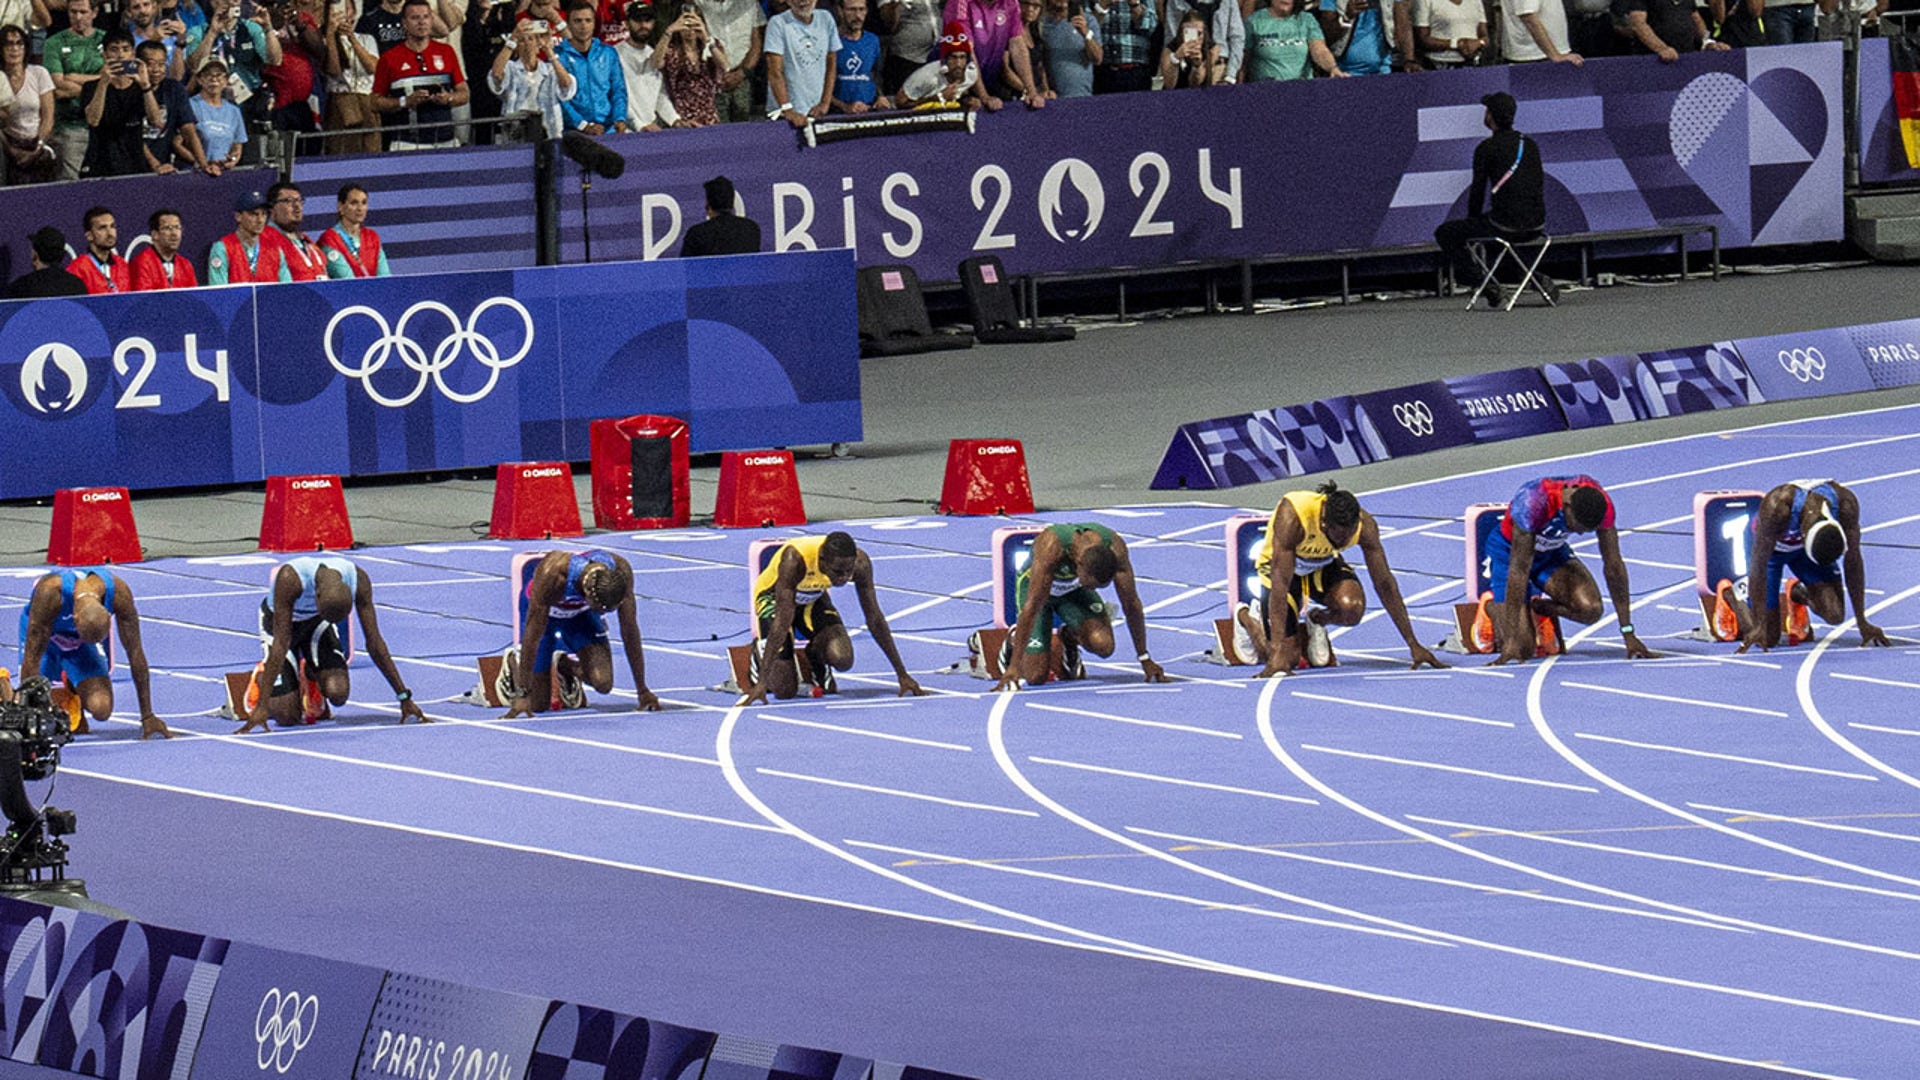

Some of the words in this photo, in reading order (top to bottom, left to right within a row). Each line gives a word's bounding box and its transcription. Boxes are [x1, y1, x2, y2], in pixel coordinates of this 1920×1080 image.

[1506, 390, 1548, 412] 2024
[986, 445, 1017, 455] OMEGA
[754, 456, 785, 466] OMEGA
[532, 468, 562, 478] OMEGA
[301, 480, 332, 489] OMEGA
[91, 492, 122, 502] OMEGA
